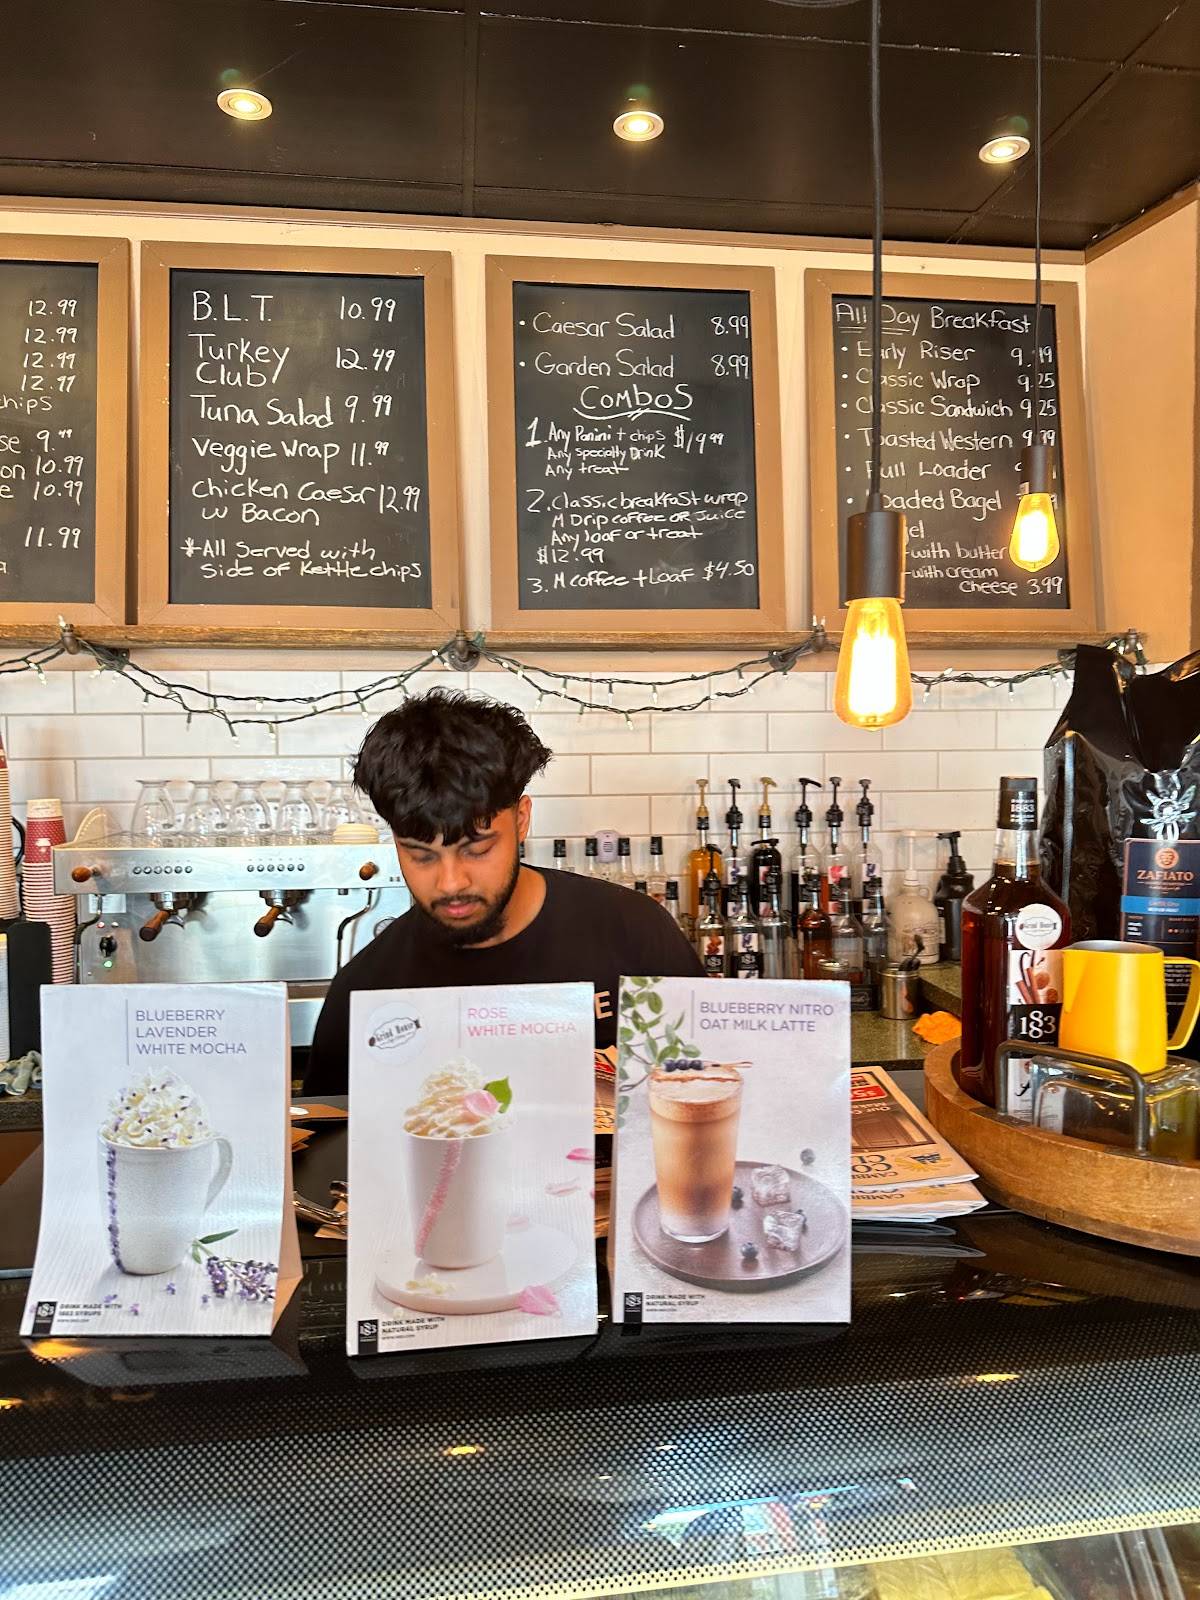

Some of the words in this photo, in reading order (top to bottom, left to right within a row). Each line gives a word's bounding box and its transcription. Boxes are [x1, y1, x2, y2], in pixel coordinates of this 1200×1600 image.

[29, 299, 77, 317] 12.99
[340, 296, 396, 322] 10.99
[836, 303, 867, 325] All
[930, 305, 1032, 333] Breakfast
[25, 327, 78, 344] 12.99
[533, 312, 610, 337] Caesar
[616, 312, 675, 339] Salad
[710, 315, 749, 339] 8.99
[24, 352, 76, 369] 12.99
[188, 333, 290, 384] Turkey
[919, 340, 976, 362] Riser
[196, 361, 267, 387] Club
[336, 347, 396, 372] 12.49
[535, 351, 611, 376] Garden
[616, 348, 675, 378] Salad
[710, 354, 749, 379] 8.99
[190, 394, 260, 425] Tuna
[266, 396, 333, 428] Salad
[345, 395, 393, 423] 9.99
[929, 395, 1014, 418] Sandwich
[549, 422, 571, 452] Any
[575, 425, 612, 442] Panini
[630, 427, 667, 443] chips
[940, 428, 1014, 452] Western
[36, 455, 84, 476] 10.99
[192, 437, 277, 475] Veggie
[547, 447, 571, 467] Any
[575, 445, 627, 466] specialty
[545, 465, 573, 480] Any
[579, 461, 630, 475] treat
[919, 459, 992, 481] Loader
[34, 480, 83, 506] 10.99
[298, 482, 375, 503] Caesar
[379, 484, 420, 513] 12.99
[704, 491, 748, 506] wrap
[242, 503, 319, 526] Bacon
[865, 488, 945, 512] oaded
[950, 488, 1002, 522] Bagel
[552, 514, 565, 528] M
[570, 513, 609, 530] Drip
[25, 526, 81, 548] 11.99
[551, 530, 580, 552] Any
[646, 525, 704, 541] treat
[321, 539, 376, 560] with
[535, 545, 604, 564] $12.99
[263, 561, 291, 577] of
[370, 561, 422, 582] chips
[553, 571, 565, 589] M
[702, 560, 755, 582] $4.50
[945, 565, 999, 580] cream
[1026, 576, 1064, 596] 3.99
[1136, 869, 1195, 882] ZAFIATO
[135, 1009, 225, 1022] BLUEBERRY
[467, 1007, 508, 1020] ROSE
[593, 990, 614, 1020] E
[700, 1001, 785, 1015] BLUEBERRY
[788, 1003, 834, 1016] NITRO
[135, 1026, 218, 1038] LAVENDER
[467, 1023, 517, 1038] WHITE
[520, 1022, 578, 1037] MOCHA
[700, 1018, 729, 1031] OAT
[733, 1019, 767, 1032] MILK
[771, 1020, 816, 1032] LATTE
[135, 1043, 186, 1055] WHITE
[189, 1042, 247, 1055] MOCHA
